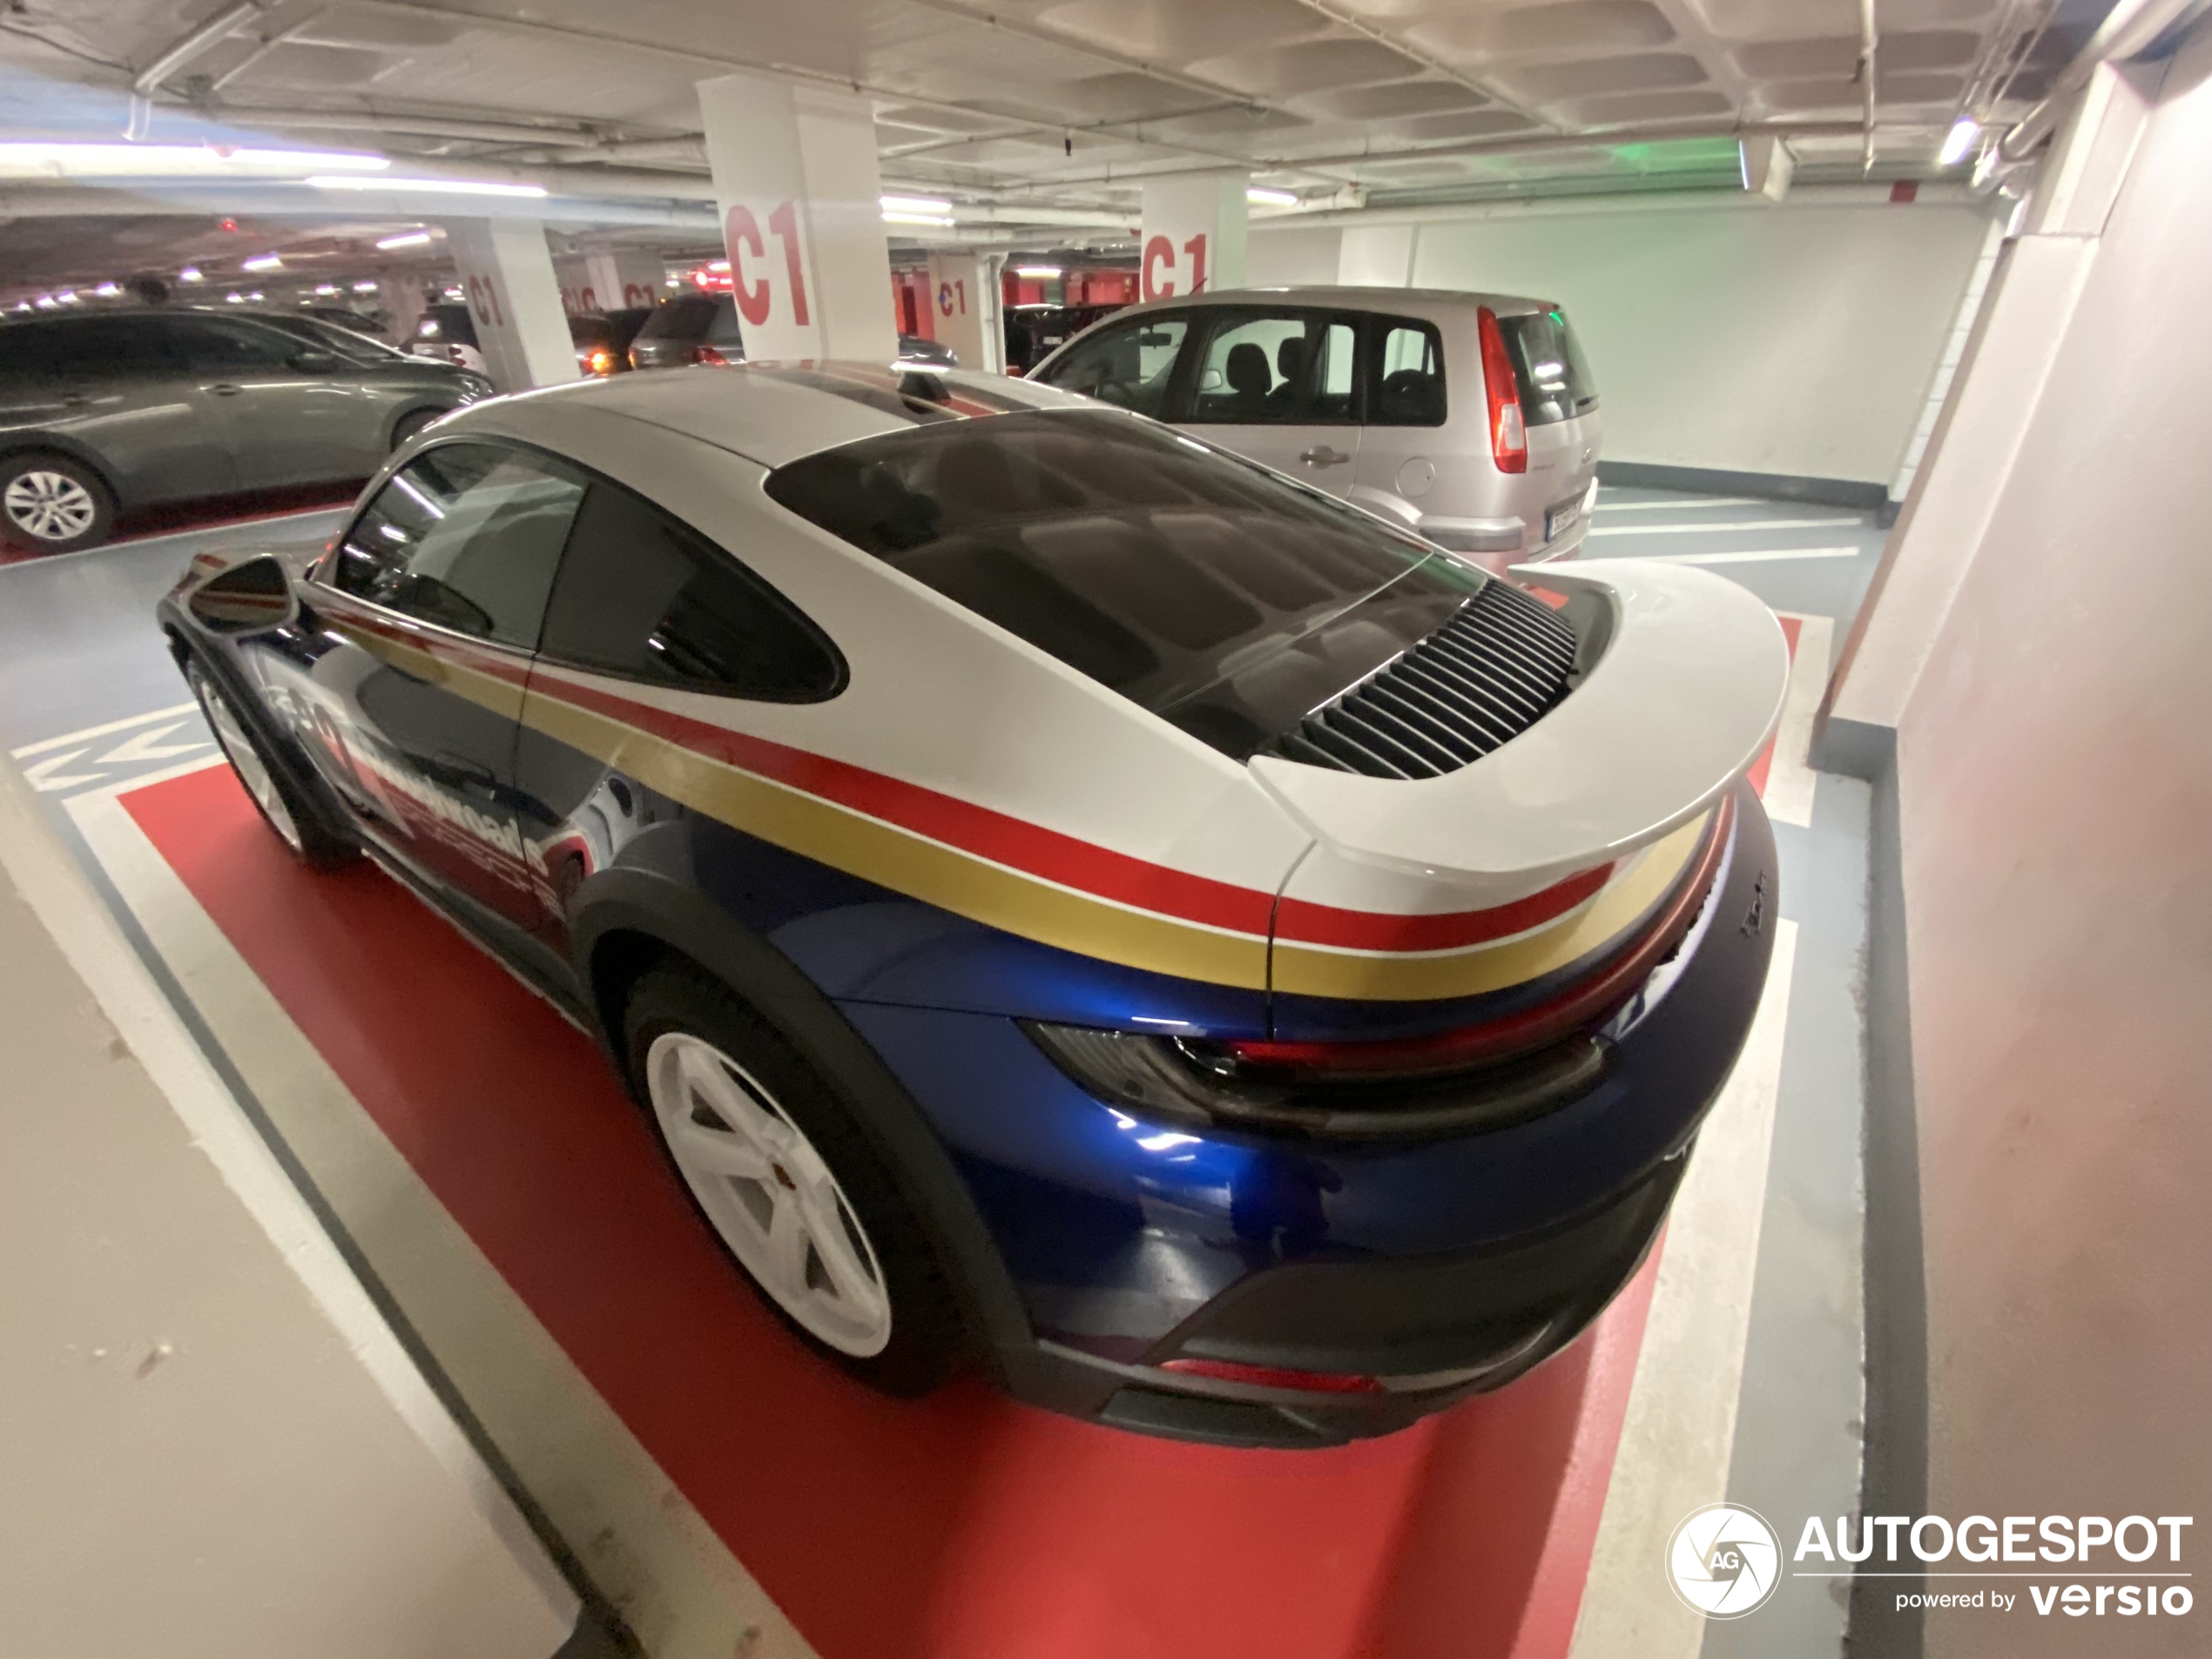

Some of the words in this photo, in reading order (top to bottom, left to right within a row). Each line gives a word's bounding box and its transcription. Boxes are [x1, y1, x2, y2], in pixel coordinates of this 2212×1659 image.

[725, 200, 810, 326] C1
[1143, 233, 1207, 304] C1
[469, 274, 504, 327] C1
[940, 280, 966, 317] C1
